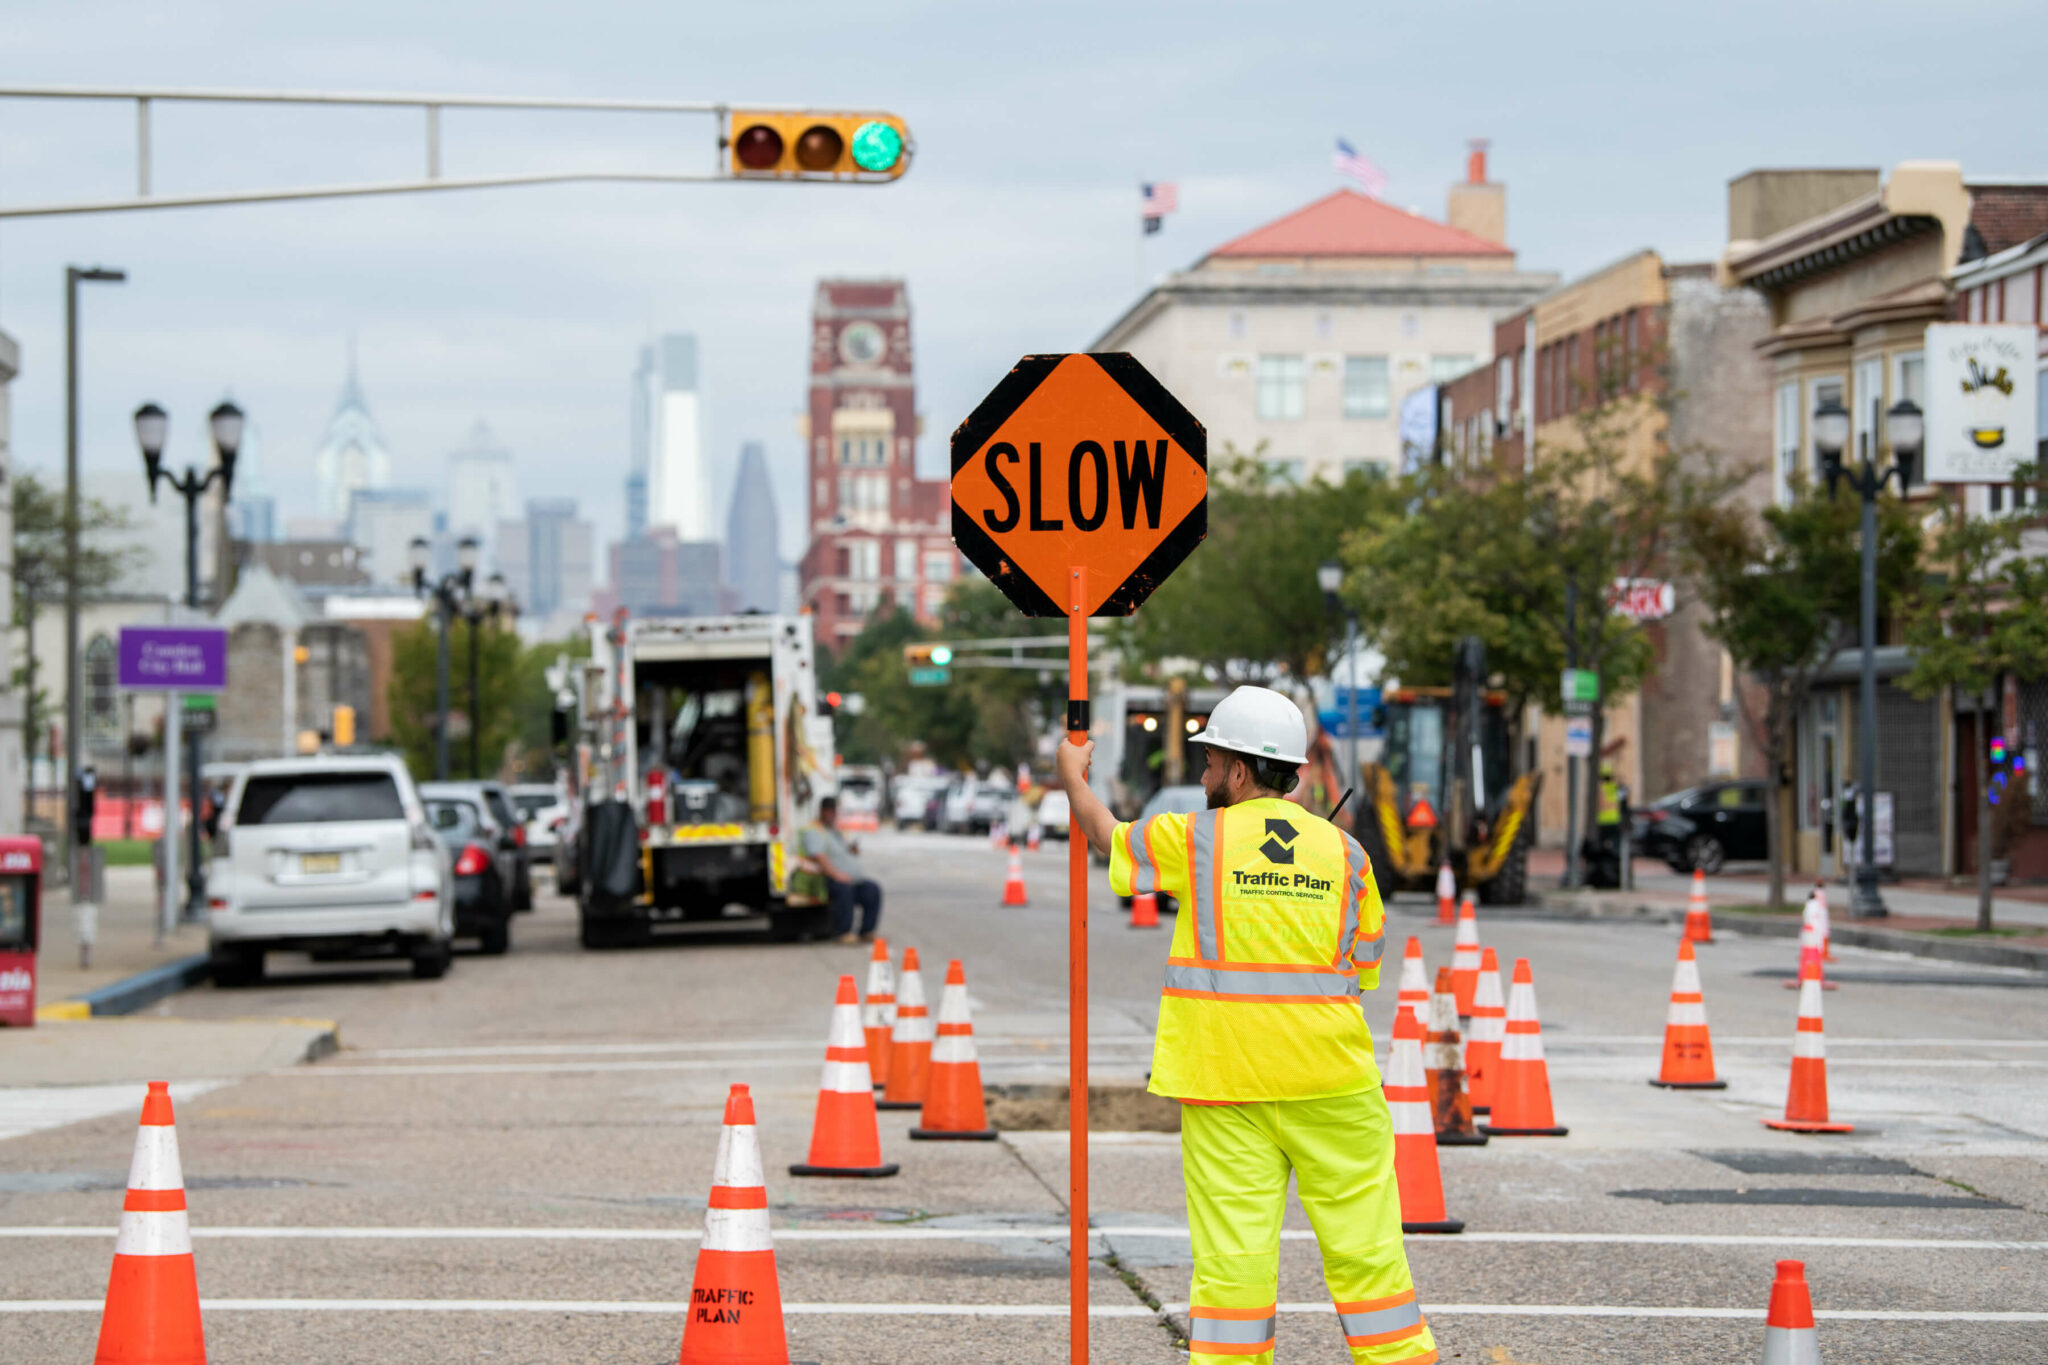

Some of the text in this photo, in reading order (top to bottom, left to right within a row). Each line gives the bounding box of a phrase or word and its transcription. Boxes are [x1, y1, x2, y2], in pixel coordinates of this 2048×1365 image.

[983, 439, 1169, 533] SLOW
[1232, 871, 1290, 887] Traffic
[1295, 891, 1324, 900] SERVICES
[693, 1288, 754, 1306] TRAFFIC
[697, 1308, 740, 1324] PLAN
